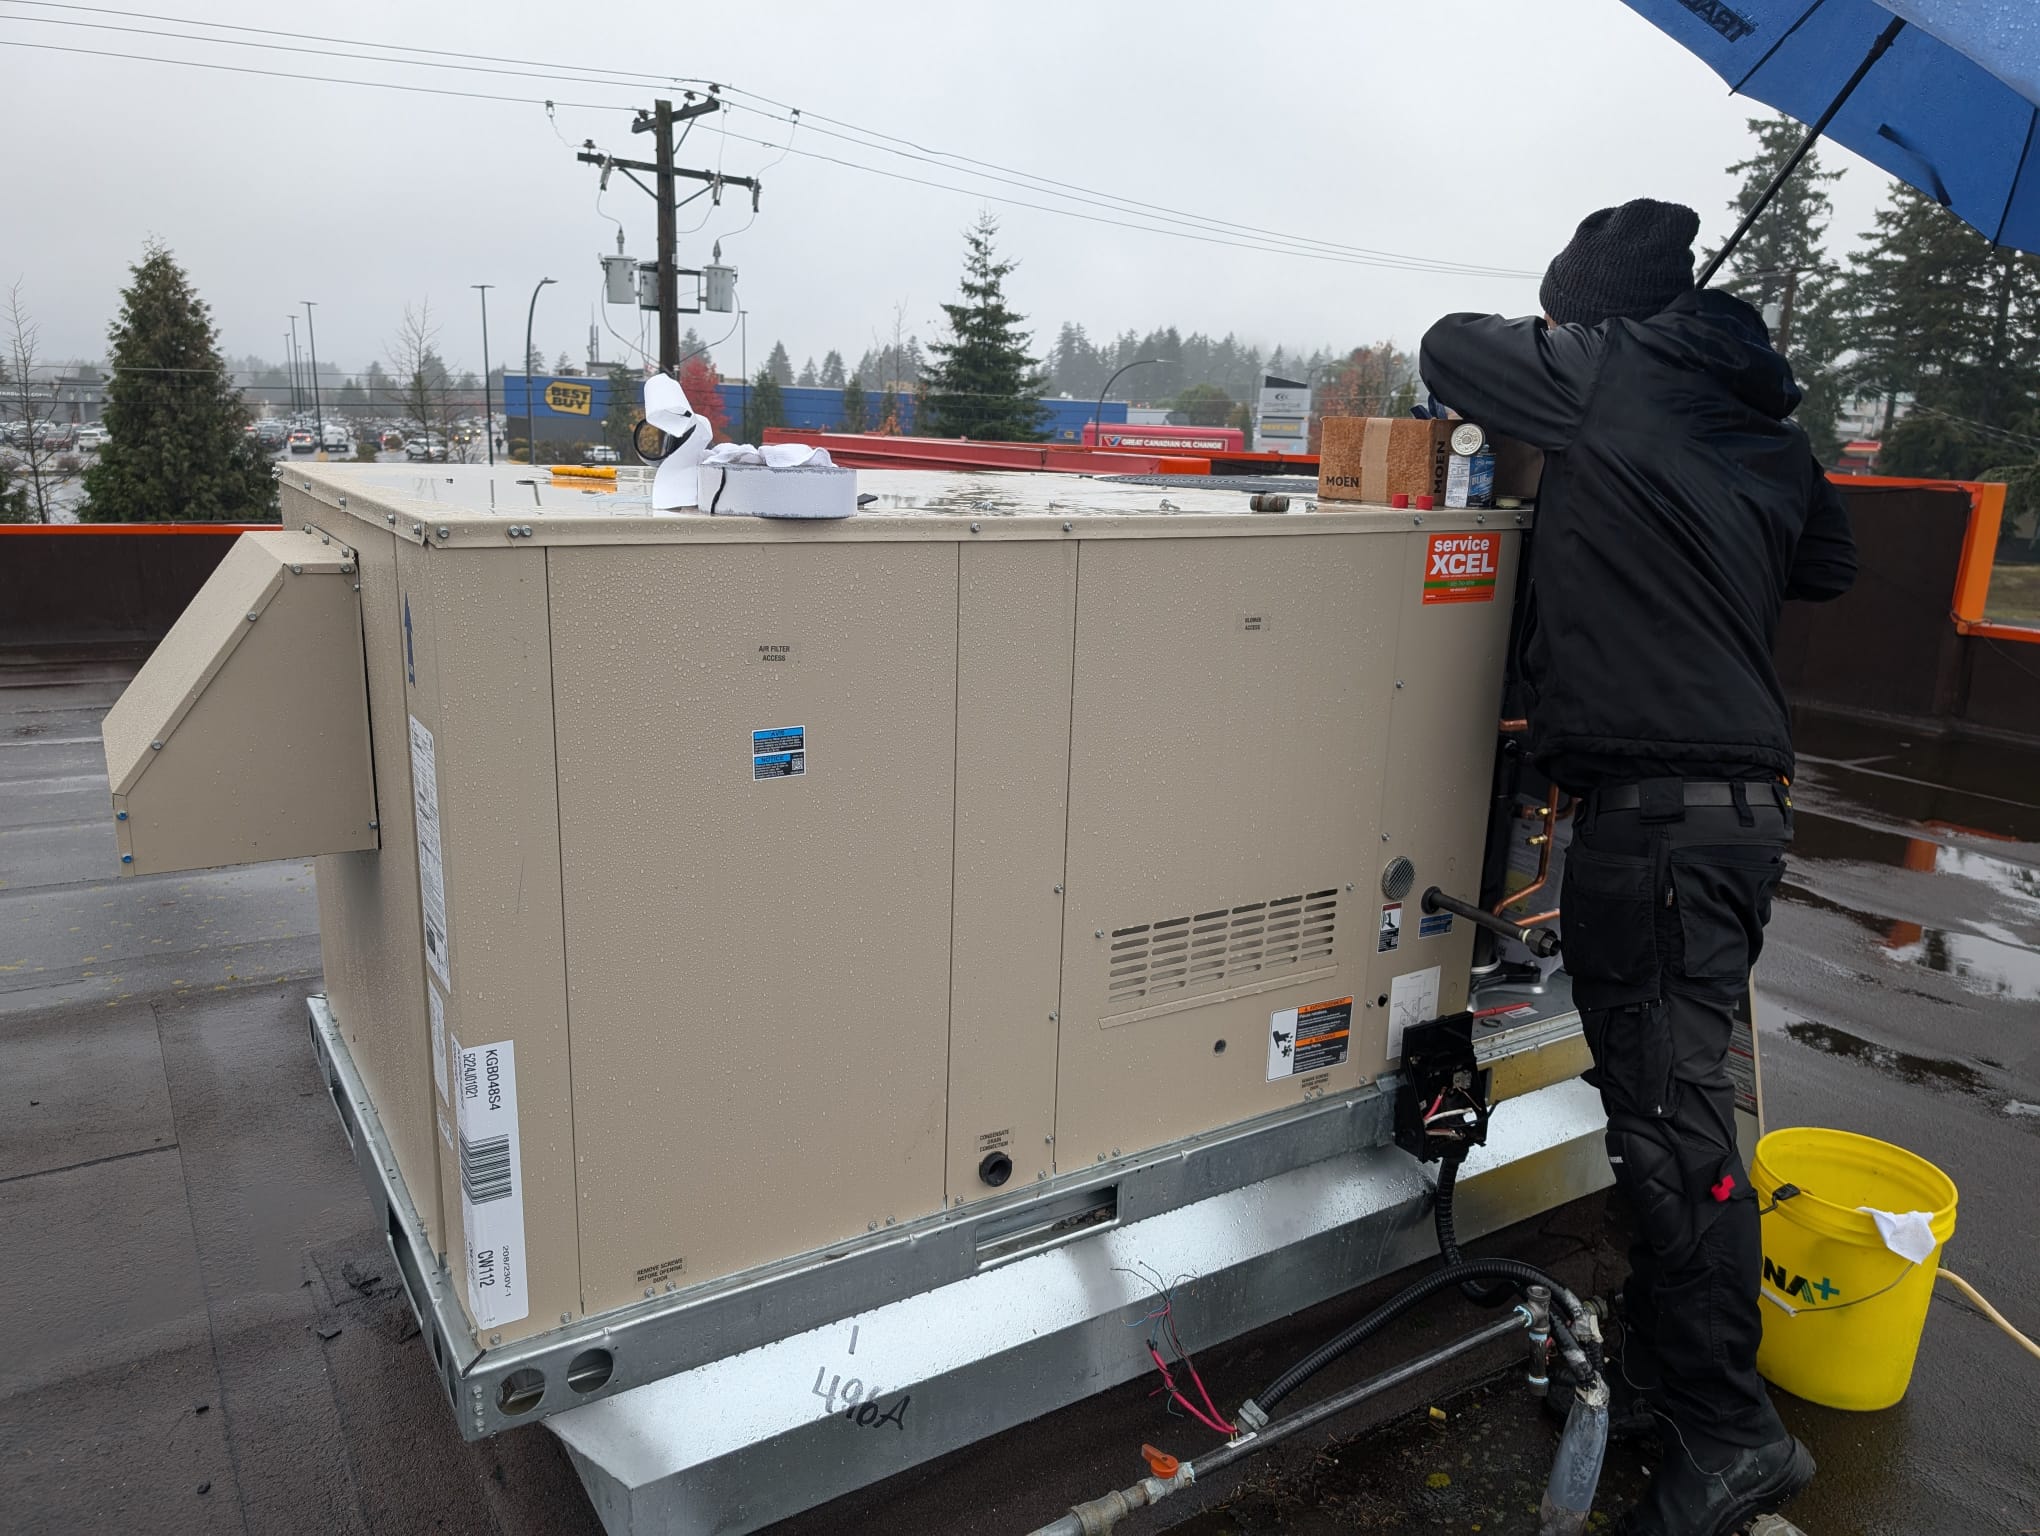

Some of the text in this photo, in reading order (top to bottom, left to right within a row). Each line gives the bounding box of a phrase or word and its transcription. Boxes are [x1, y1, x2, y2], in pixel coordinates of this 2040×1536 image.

[551, 386, 590, 400] BEST
[552, 396, 586, 409] BUY
[1121, 438, 1223, 449] GREAT CANADIAN OIL CHANGE
[1433, 440, 1446, 494] MOEN
[1326, 476, 1359, 487] MOEN
[1434, 535, 1490, 553] service
[1429, 553, 1494, 575] XCEL
[485, 1048, 502, 1111] KGB048S4
[477, 1249, 495, 1289] CW112
[636, 1257, 683, 1275] REMOVE SCREWS
[637, 1271, 659, 1282] BEFORE
[652, 1274, 668, 1284] DOOR
